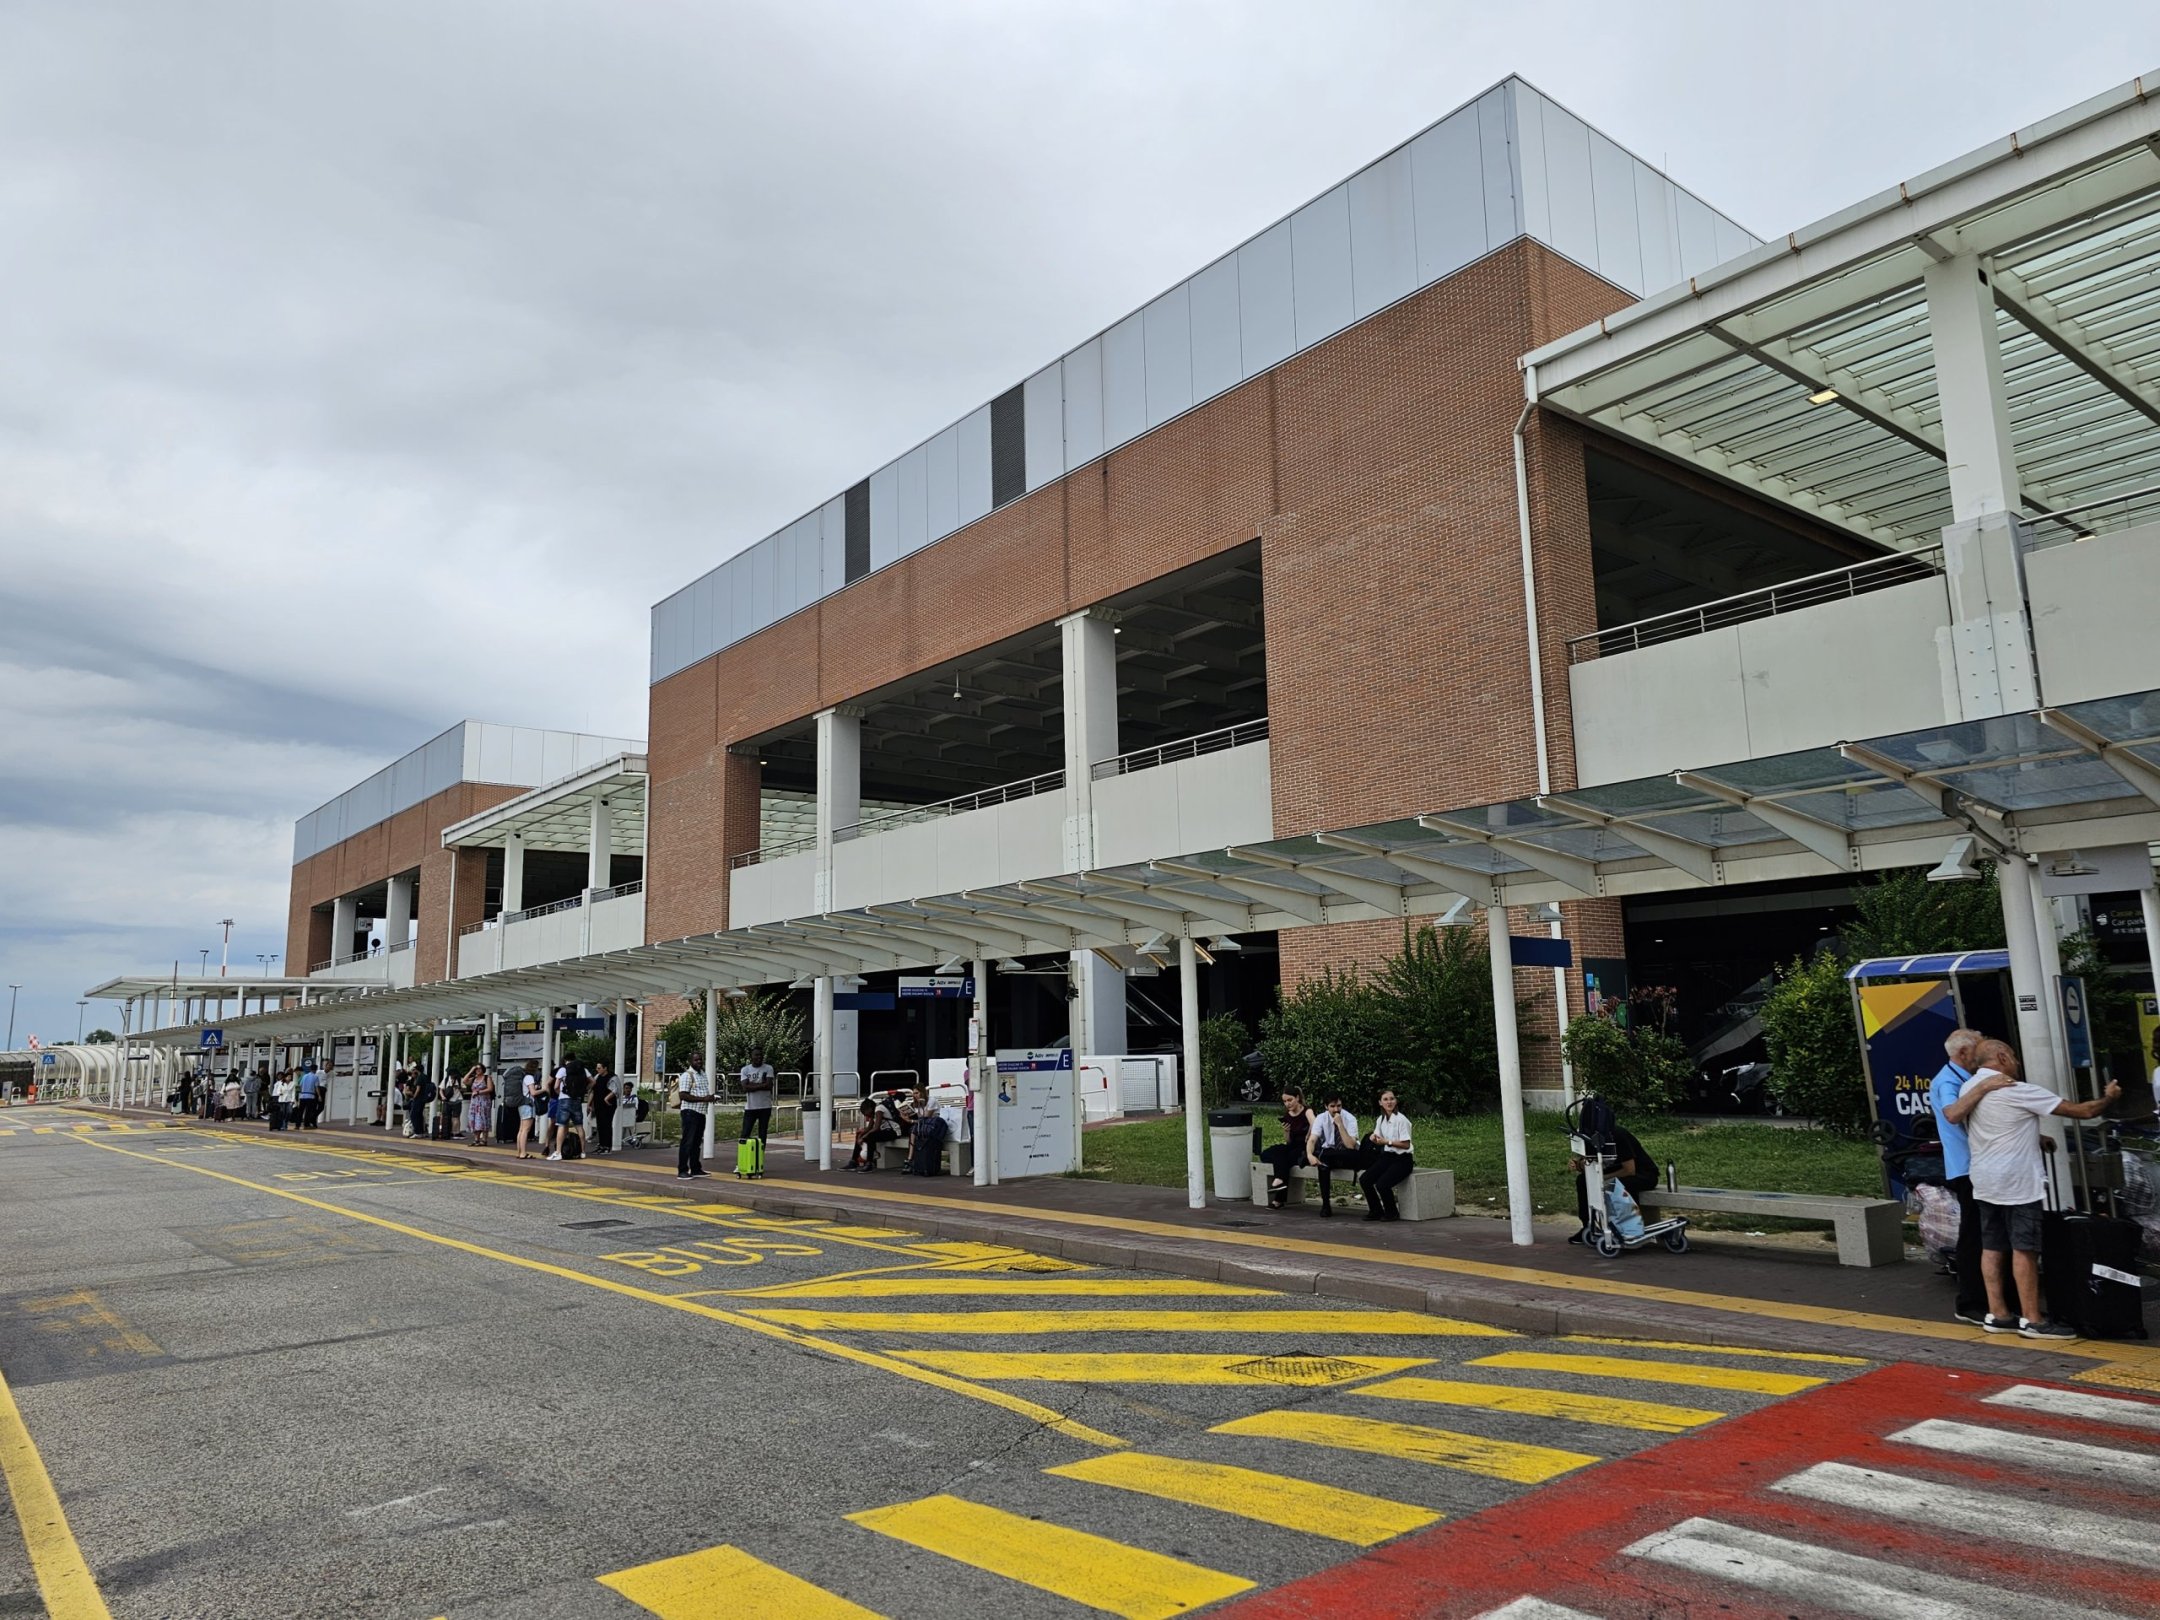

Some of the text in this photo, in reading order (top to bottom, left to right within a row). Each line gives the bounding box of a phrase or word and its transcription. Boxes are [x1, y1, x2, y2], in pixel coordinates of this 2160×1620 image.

[965, 981, 972, 995] E
[2146, 1001, 2157, 1013] P
[1063, 1054, 1070, 1068] E
[1894, 1074, 1931, 1090] 24 ho
[1895, 1092, 1931, 1115] CAS
[272, 1168, 394, 1181] BUS
[598, 1237, 824, 1276] BUS
